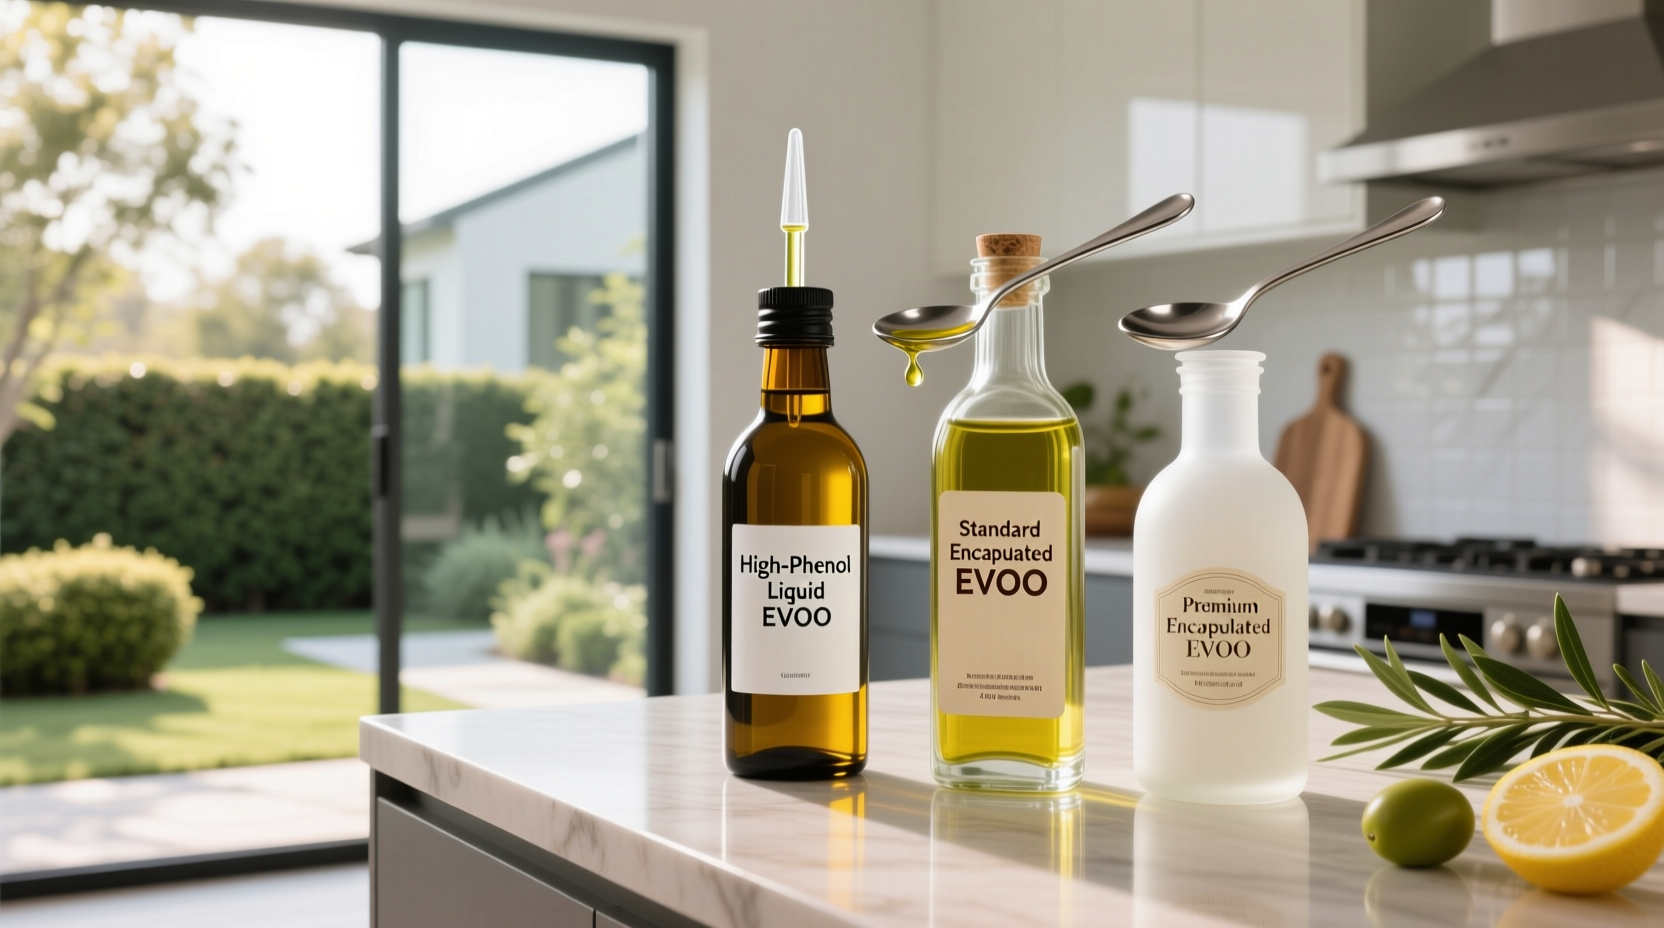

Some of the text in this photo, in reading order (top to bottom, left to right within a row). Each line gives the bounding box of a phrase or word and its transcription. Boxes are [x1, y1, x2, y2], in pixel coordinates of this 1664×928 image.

[959, 519, 1041, 538] Standard
[740, 553, 851, 579] High-Phenol
[956, 568, 1048, 597] EVOO
[1183, 596, 1259, 614] Premium
[763, 606, 832, 627] EVOO
[1166, 616, 1271, 639] Encapulated
[1186, 639, 1251, 658] EVOO
